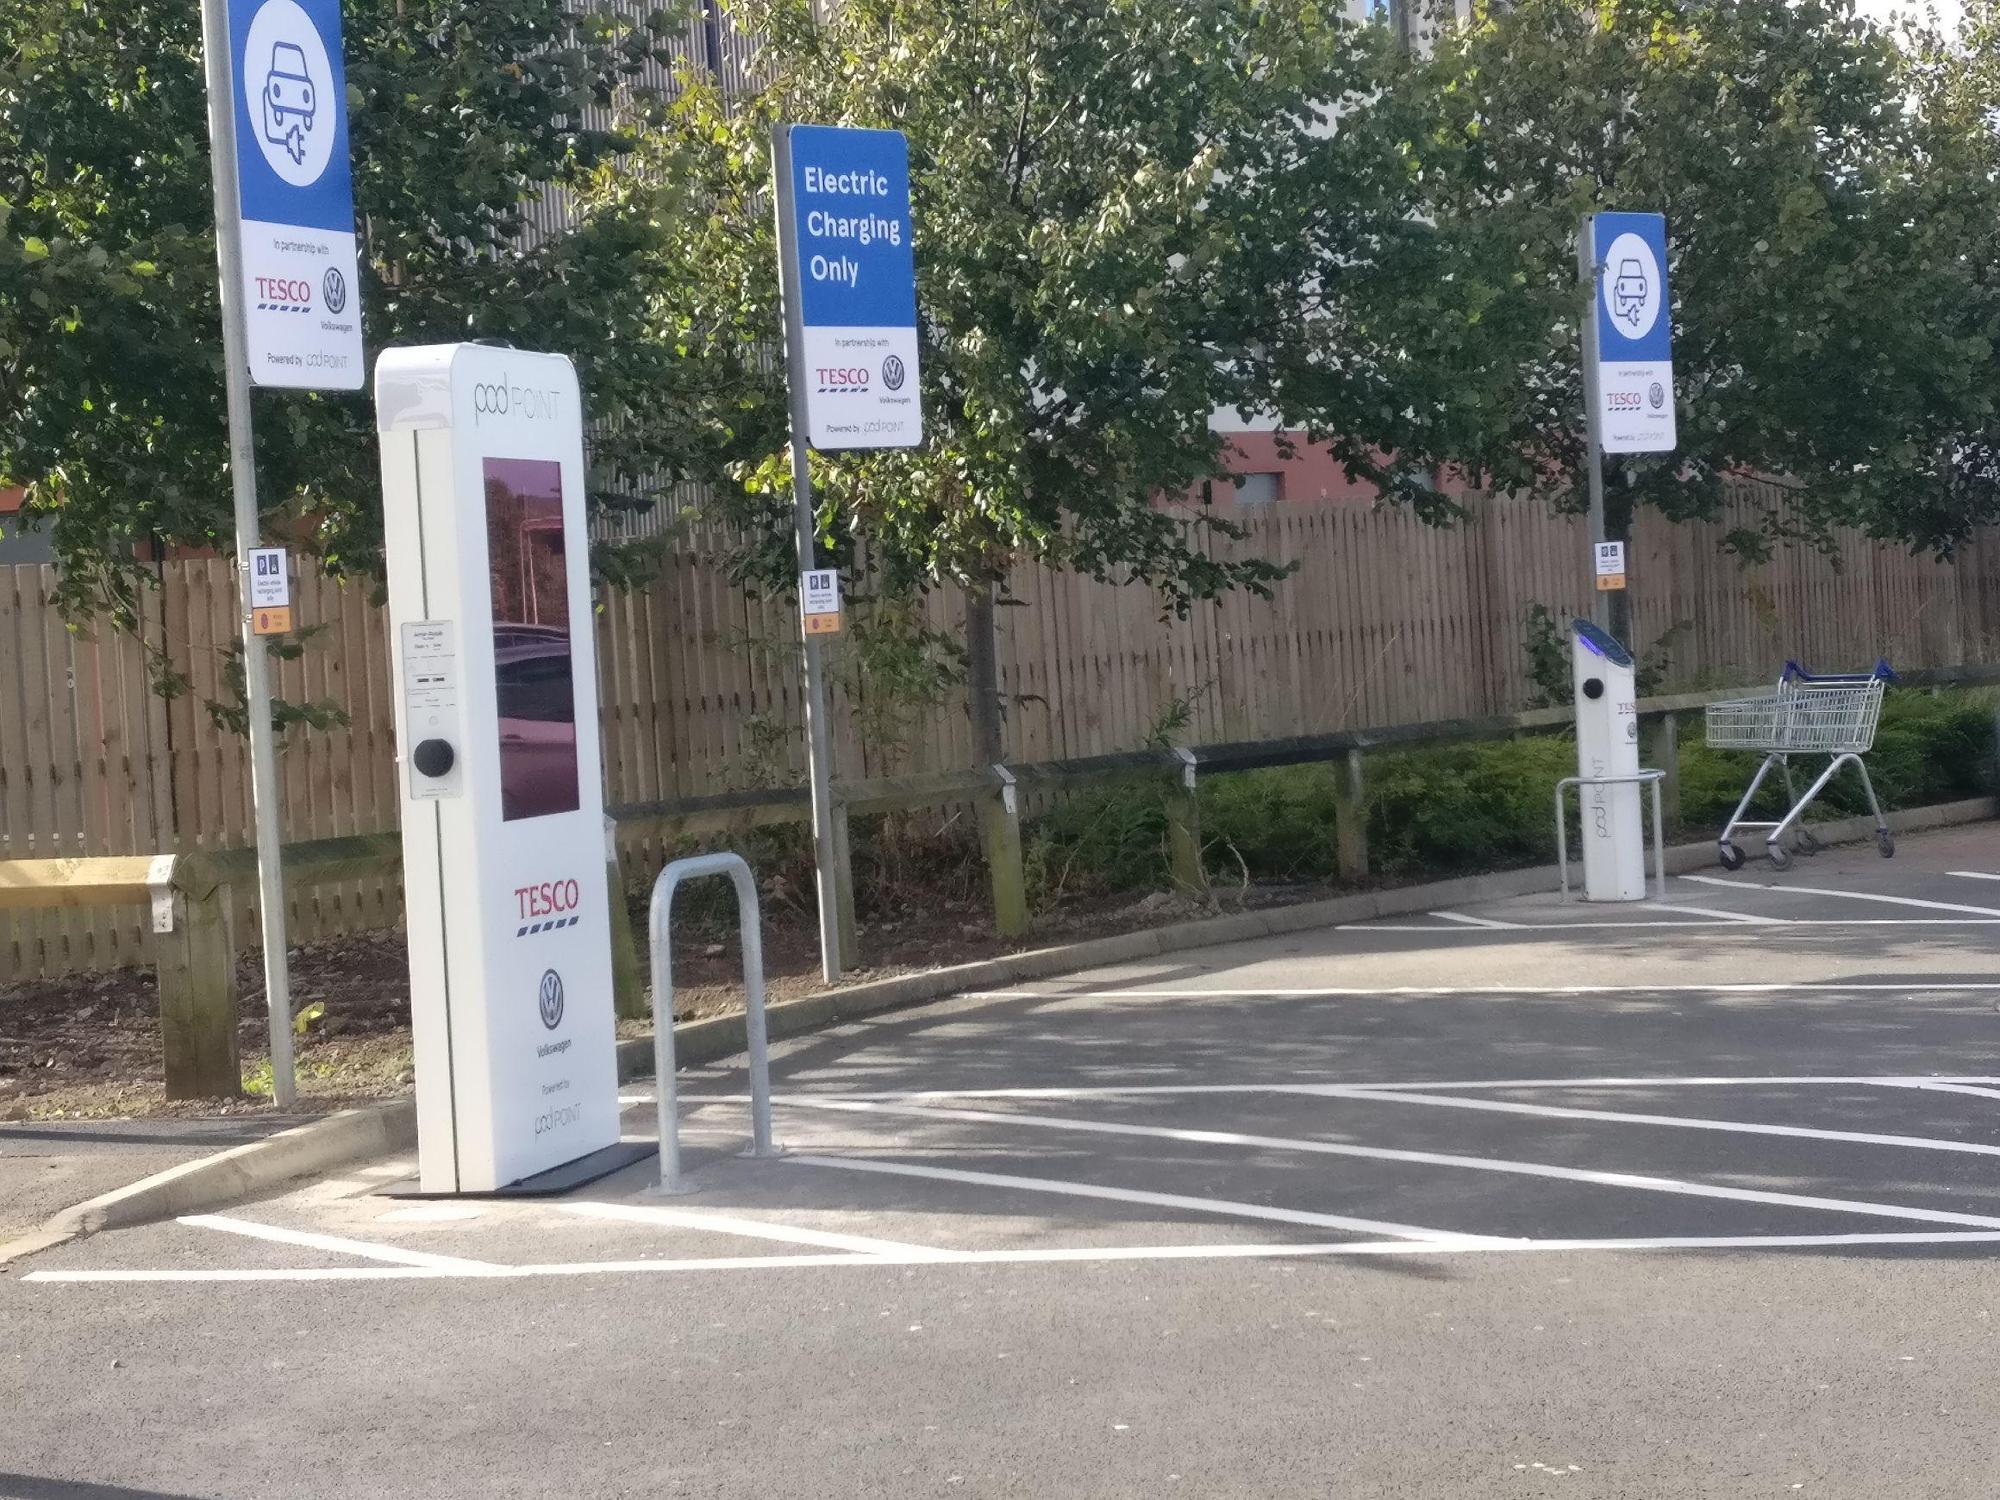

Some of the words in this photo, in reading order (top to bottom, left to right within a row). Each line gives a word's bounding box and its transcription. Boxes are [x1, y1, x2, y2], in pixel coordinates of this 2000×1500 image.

[804, 166, 888, 196] Electric
[808, 210, 901, 246] Charging
[273, 239, 280, 250] In
[281, 241, 316, 256] partnership
[317, 245, 329, 255] with
[811, 254, 859, 288] Only
[255, 277, 311, 303] TESCO
[320, 320, 353, 334] Volkswagen
[841, 338, 876, 349] partnership
[877, 338, 890, 348] with
[267, 352, 294, 366] Powered
[294, 354, 302, 368] by
[816, 367, 870, 386] TESCO
[1606, 392, 1642, 406] TESCO
[825, 423, 852, 434] Powered
[514, 878, 579, 919] TESCO
[536, 1039, 571, 1058] Volkswagen
